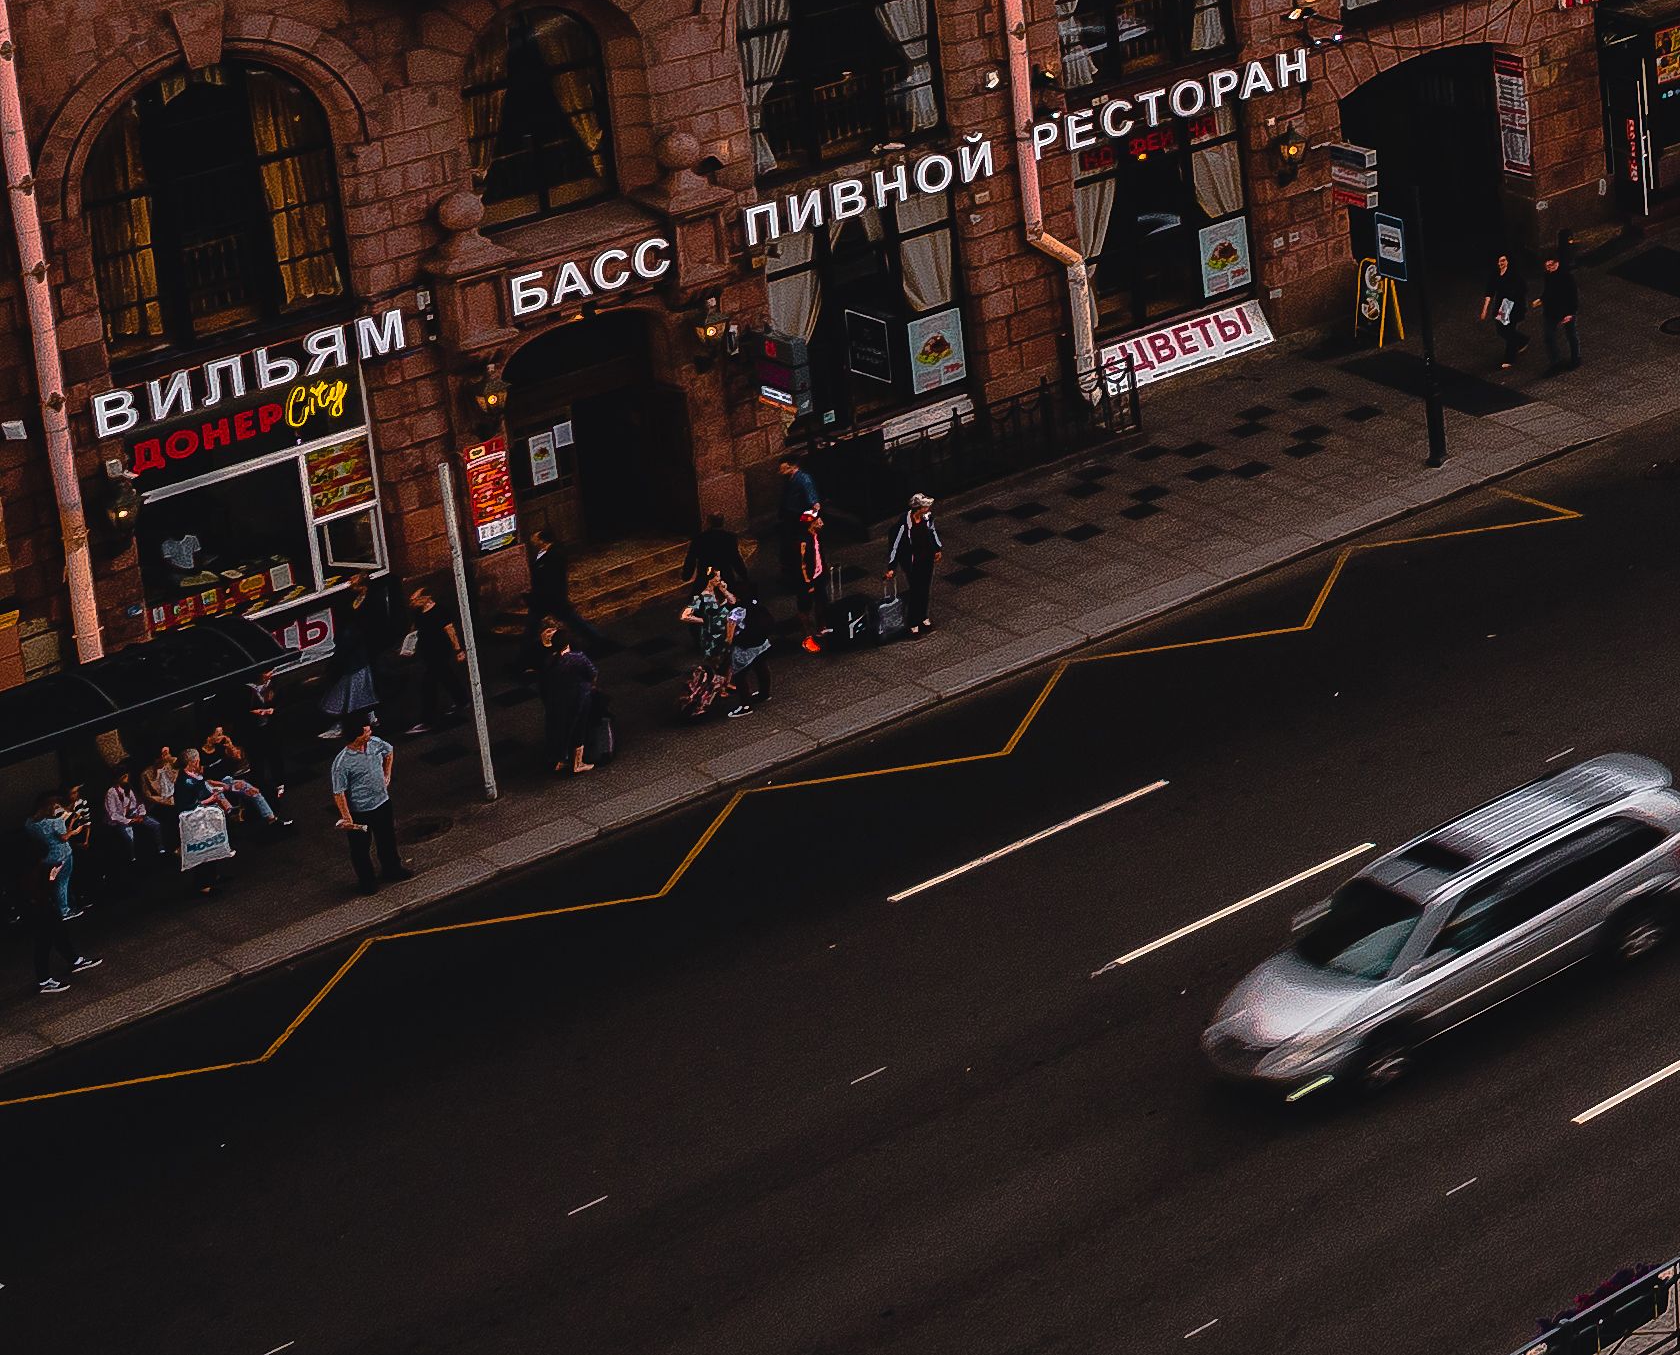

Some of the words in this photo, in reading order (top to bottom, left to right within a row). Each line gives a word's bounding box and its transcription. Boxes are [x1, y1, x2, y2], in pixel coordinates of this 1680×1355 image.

[745, 132, 995, 246] ПИВНОЙ
[1032, 49, 1308, 160] РЕСТОРАН
[511, 237, 671, 316] БАСС
[93, 309, 406, 438] ВИЛЬЯМ
[1118, 306, 1252, 370] ЦВЕТЫ
[133, 403, 283, 475] ДОНЕР
[285, 379, 348, 428] City
